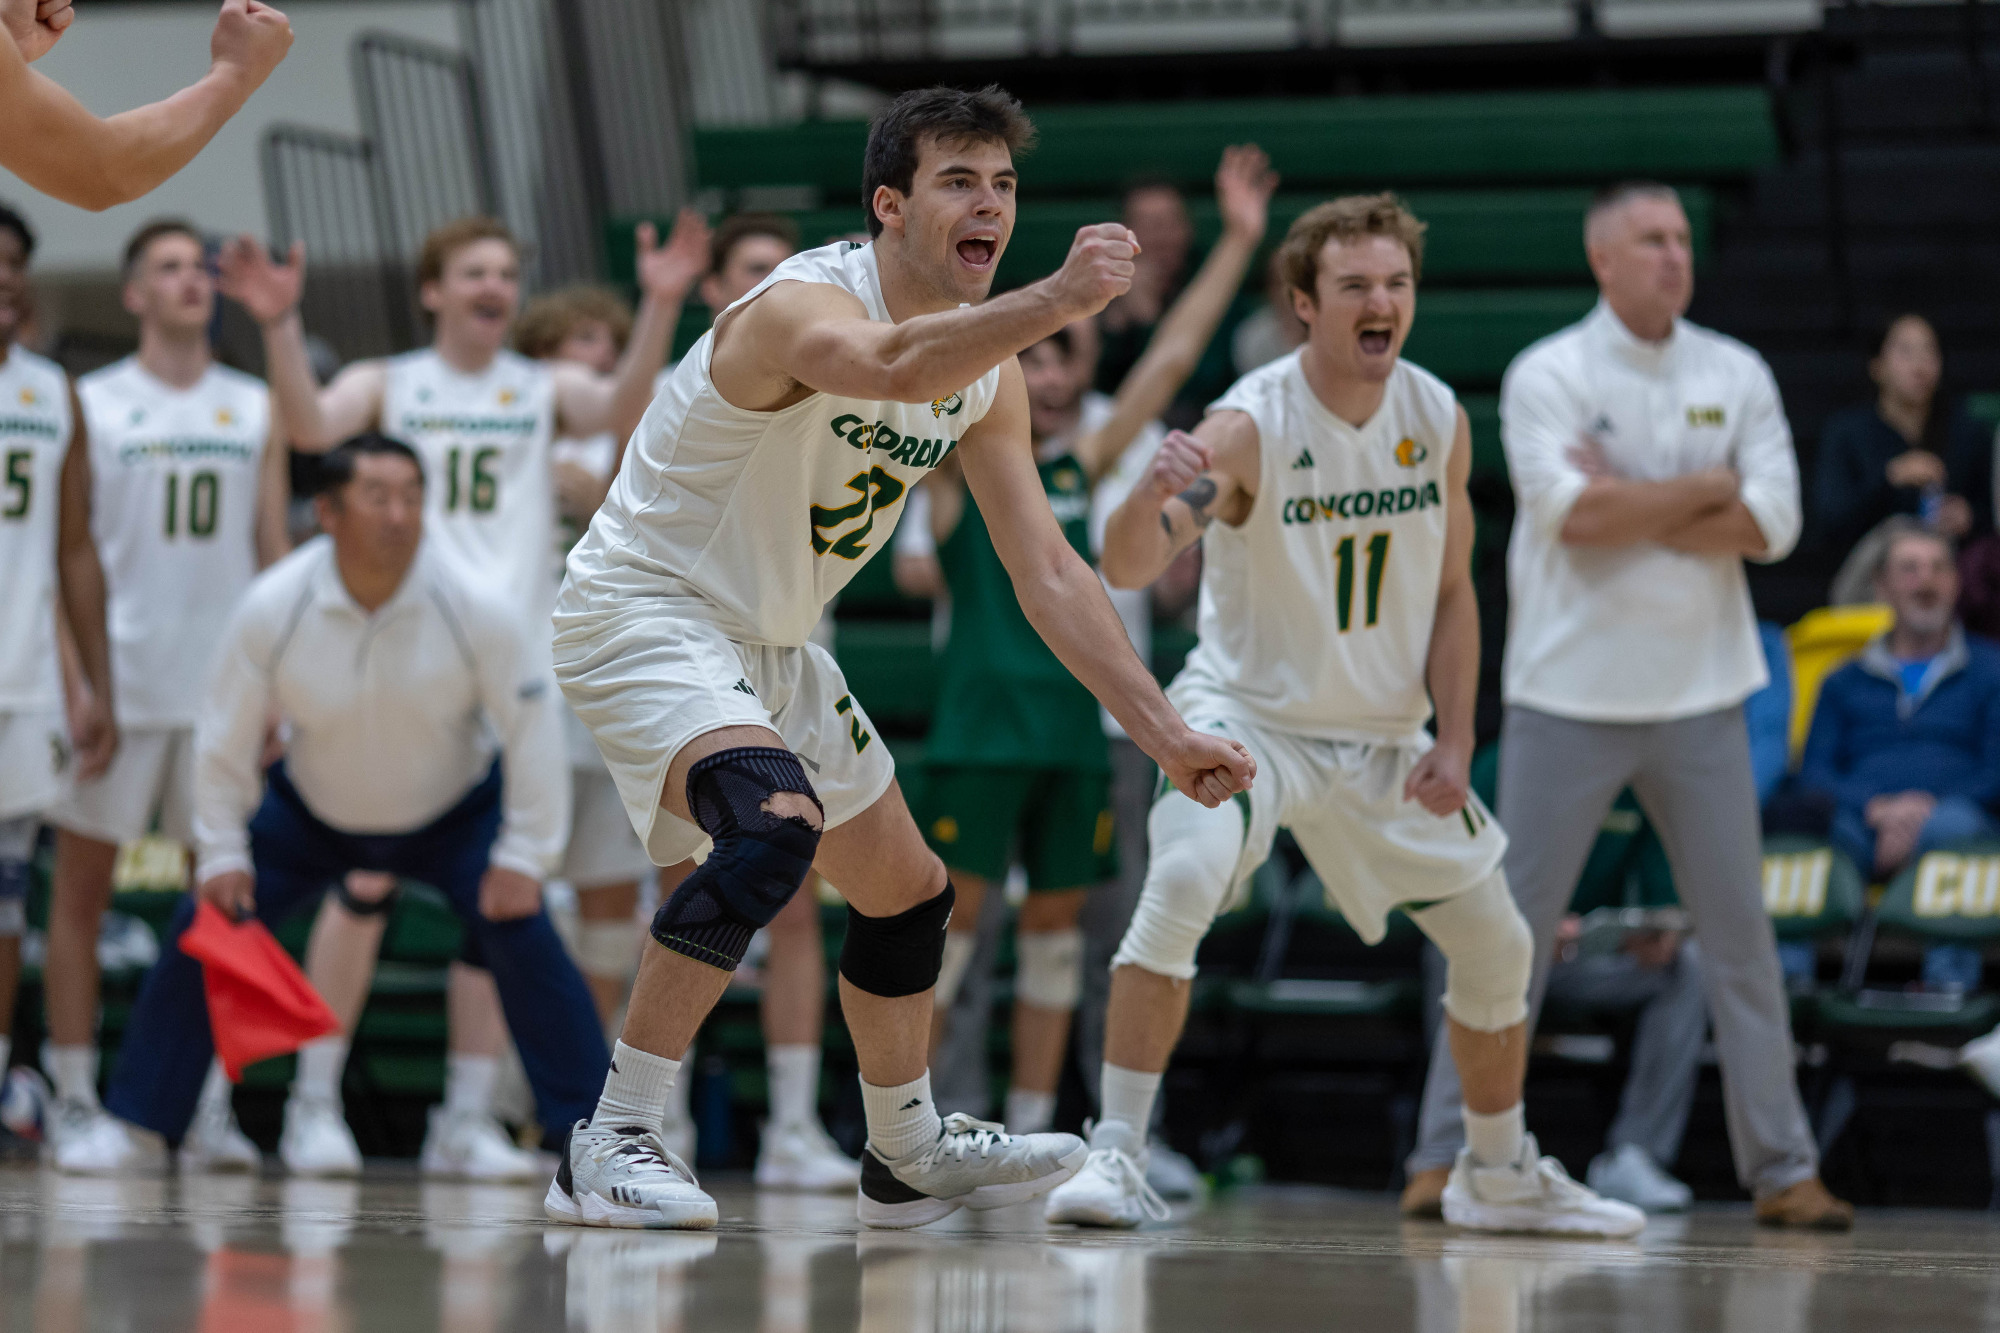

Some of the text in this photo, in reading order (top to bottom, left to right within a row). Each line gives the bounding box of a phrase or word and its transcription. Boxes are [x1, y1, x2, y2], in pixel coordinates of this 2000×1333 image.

[164, 470, 218, 538] 10
[447, 447, 501, 514] 16
[809, 464, 905, 560] 22
[1283, 481, 1440, 524] CONCORDIA
[1334, 531, 1390, 634] 11
[1762, 848, 1833, 917] UI
